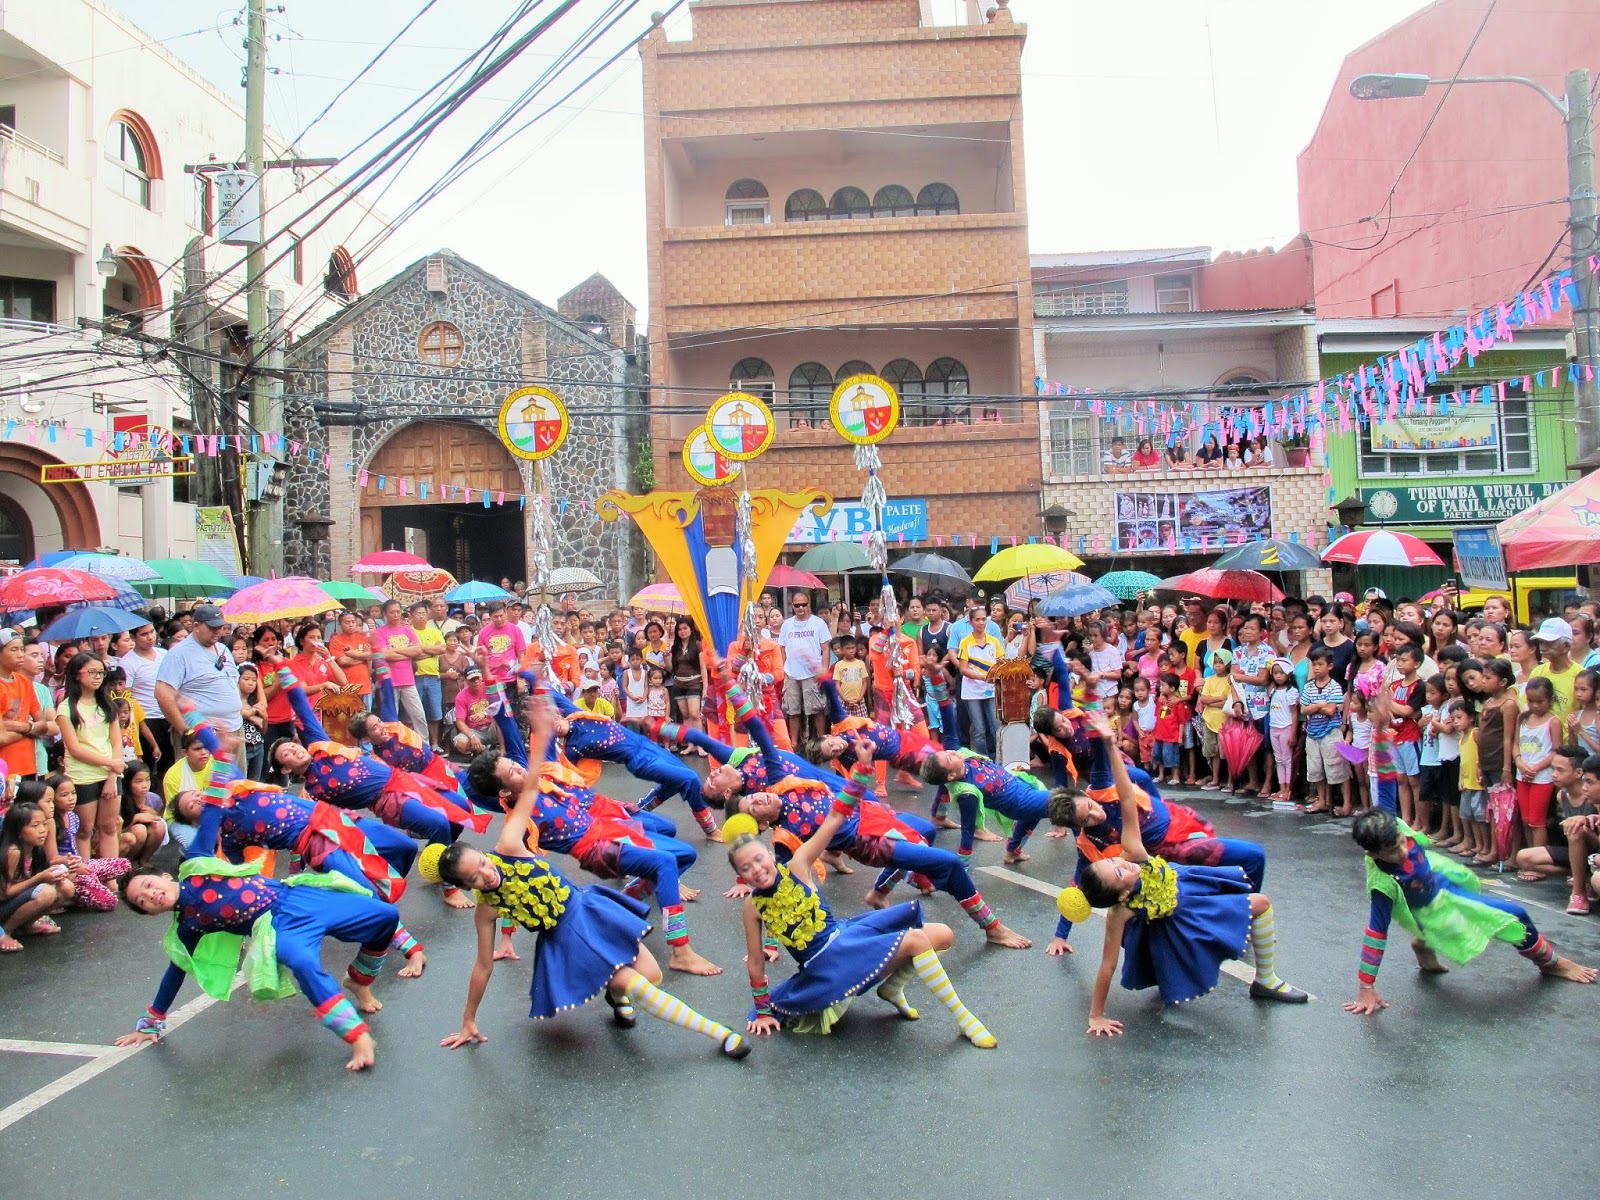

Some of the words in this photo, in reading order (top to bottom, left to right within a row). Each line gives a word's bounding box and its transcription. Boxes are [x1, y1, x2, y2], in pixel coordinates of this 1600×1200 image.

[98, 460, 141, 478] ERMITA
[1407, 485, 1477, 501] TURUMBA
[1483, 484, 1534, 498] RURAL
[886, 504, 922, 516] PAETE
[1416, 498, 1437, 513] OF
[1443, 511, 1473, 519] PAETE
[1477, 509, 1513, 518] BRANCH
[887, 515, 921, 537] Handicraft
